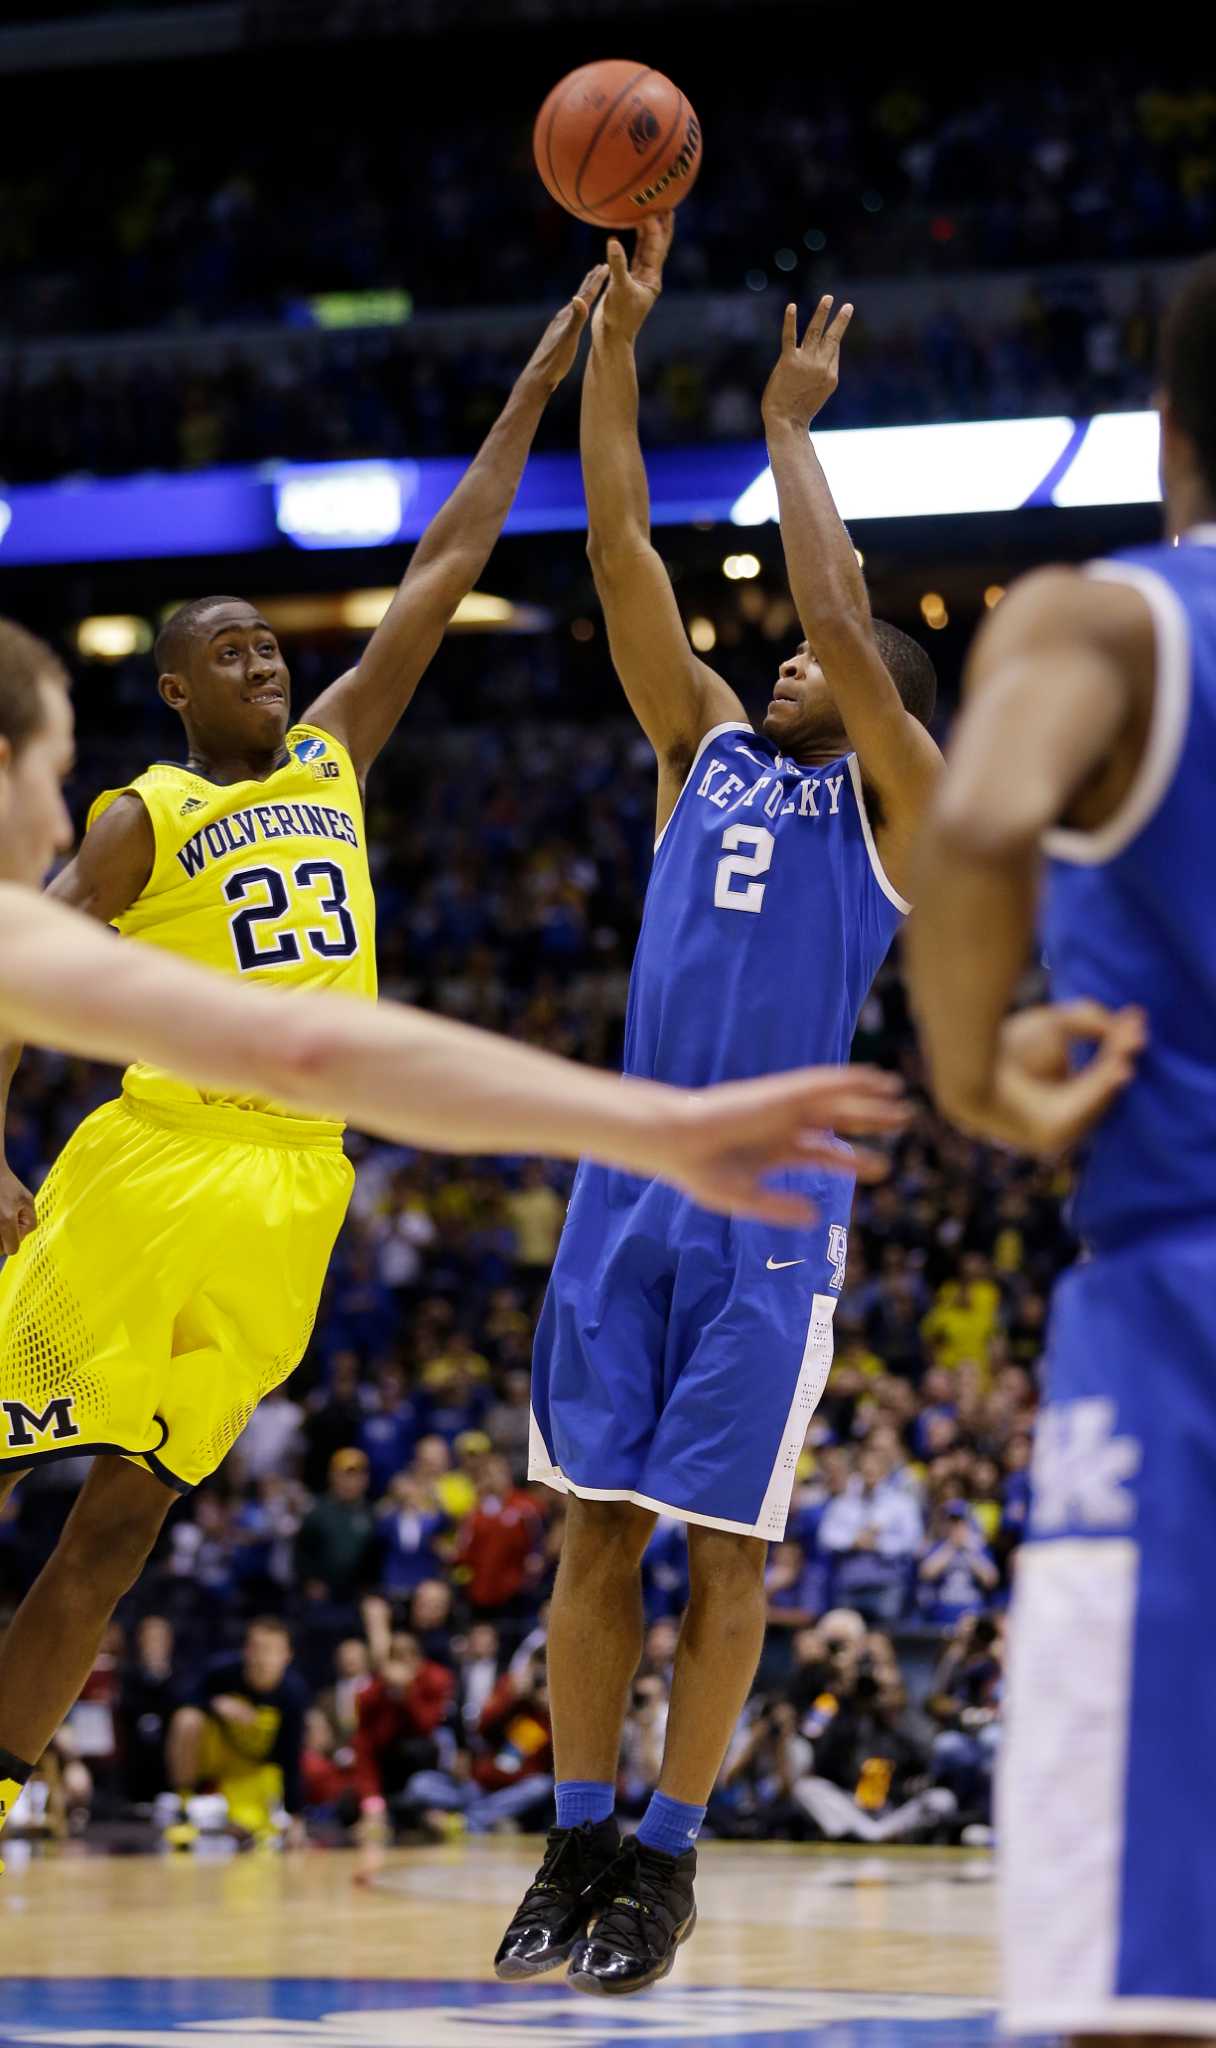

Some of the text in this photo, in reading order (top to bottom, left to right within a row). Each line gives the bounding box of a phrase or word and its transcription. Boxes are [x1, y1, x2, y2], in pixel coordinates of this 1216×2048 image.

[176, 804, 359, 880] WOLVERINES
[714, 823, 775, 914] 2
[220, 859, 359, 973] 23
[2, 1397, 80, 1447] M
